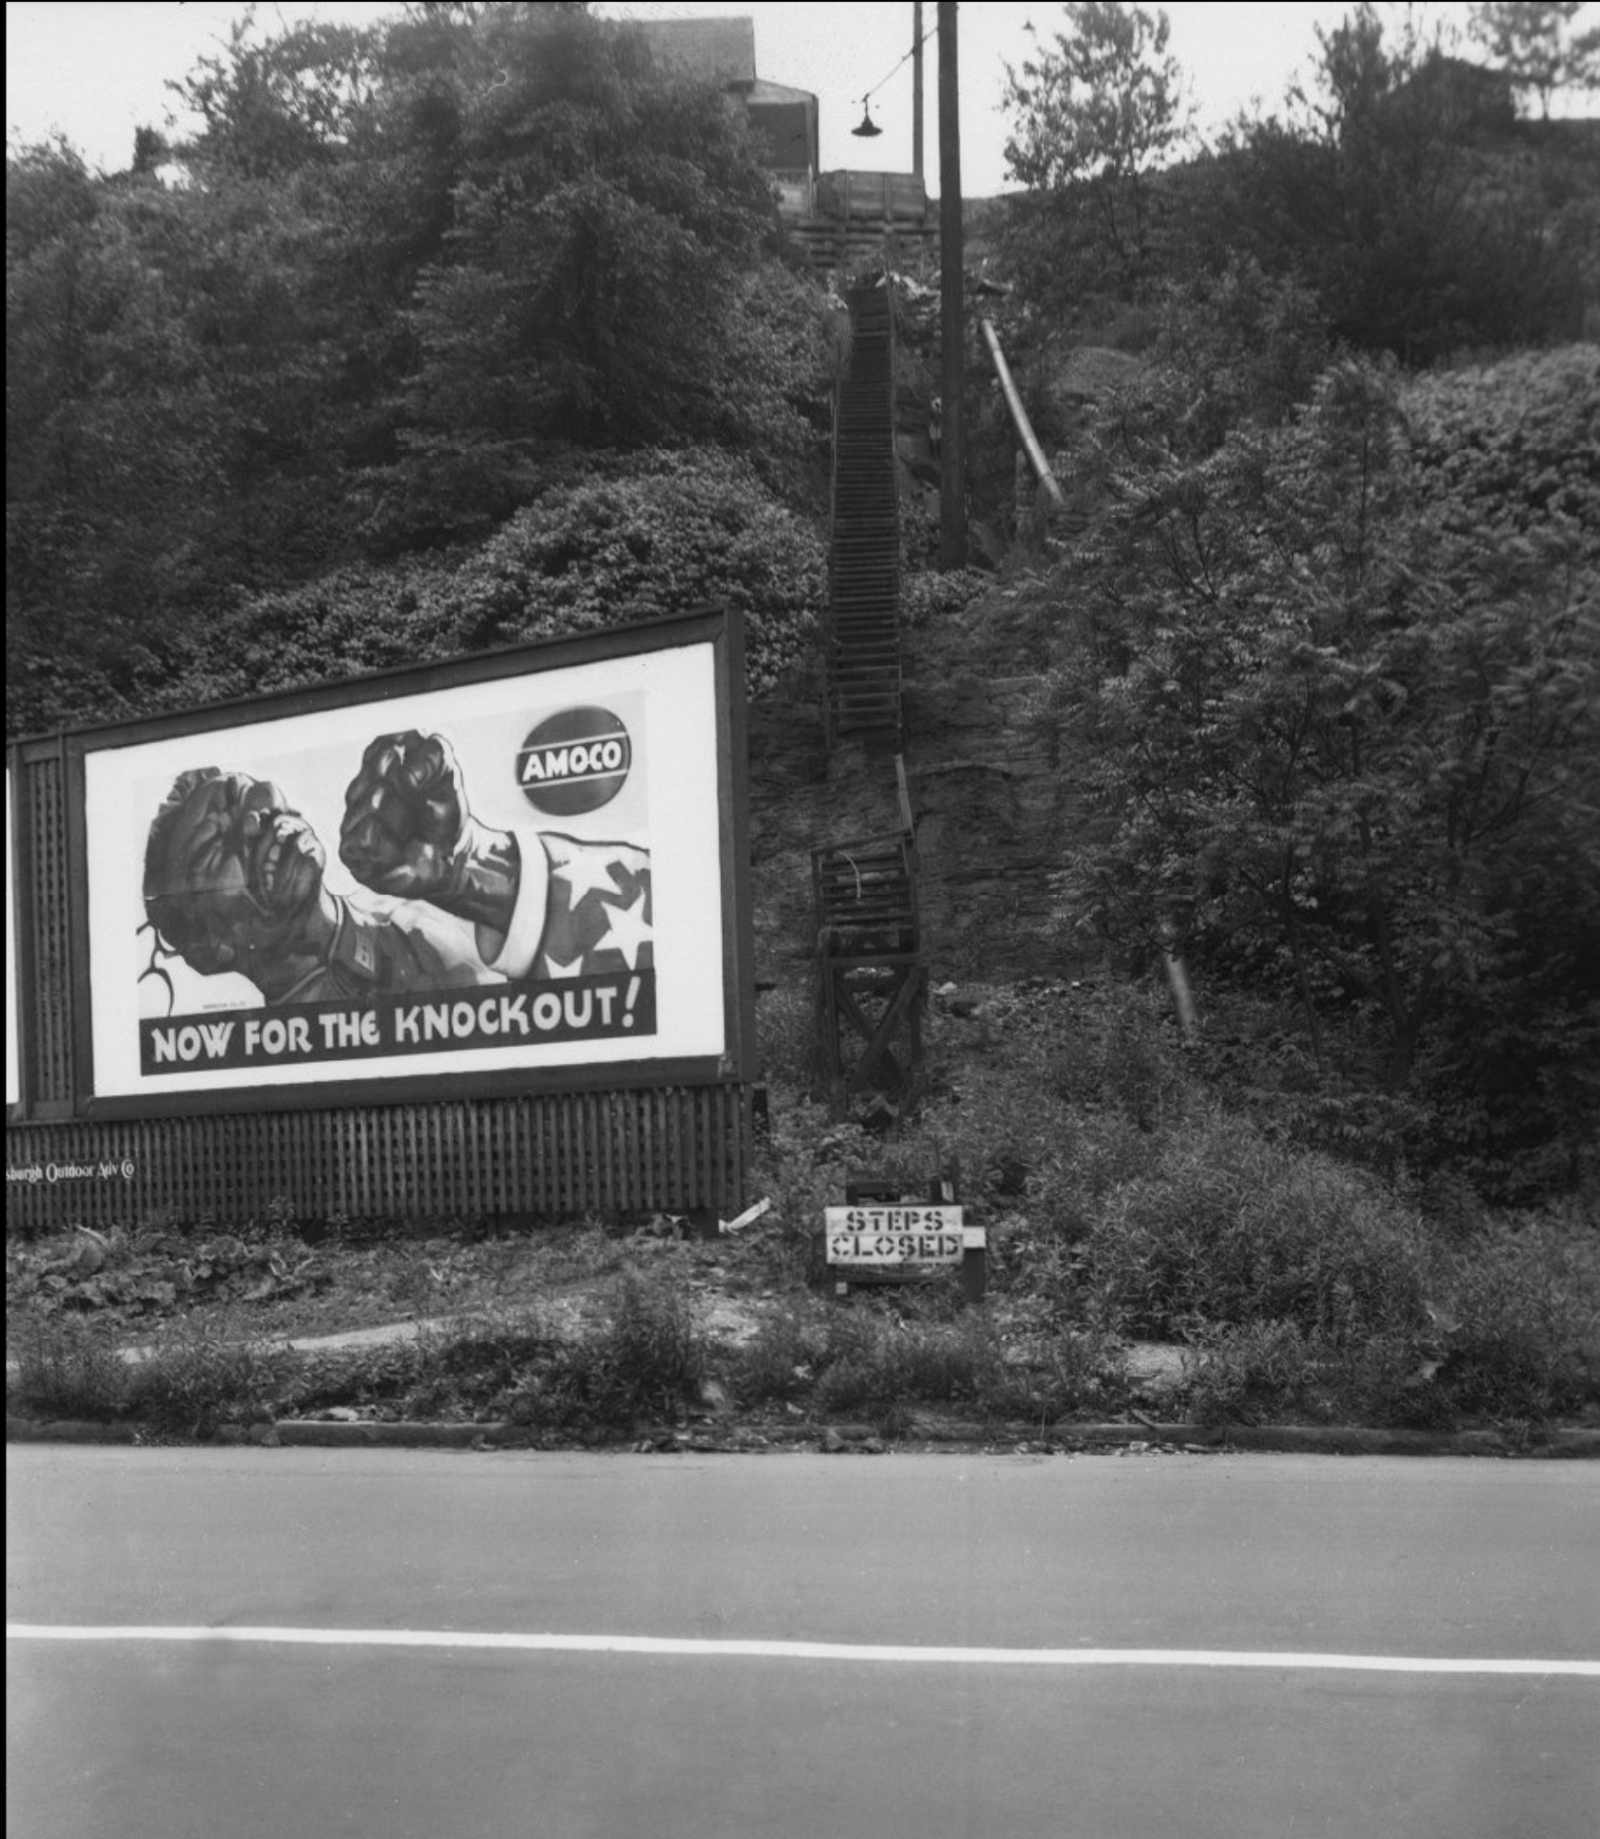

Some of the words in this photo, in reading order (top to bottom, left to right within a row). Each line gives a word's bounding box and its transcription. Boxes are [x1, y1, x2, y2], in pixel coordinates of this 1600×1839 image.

[522, 740, 622, 782] AMOCO
[151, 1021, 235, 1063] NOW
[245, 1016, 313, 1055] FOR
[319, 1010, 380, 1048] THE
[395, 976, 641, 1043] KNOCKOUT!
[46, 1162, 95, 1182] Outdoor
[847, 1211, 943, 1231] STEPS
[832, 1235, 958, 1257] CLOSED
